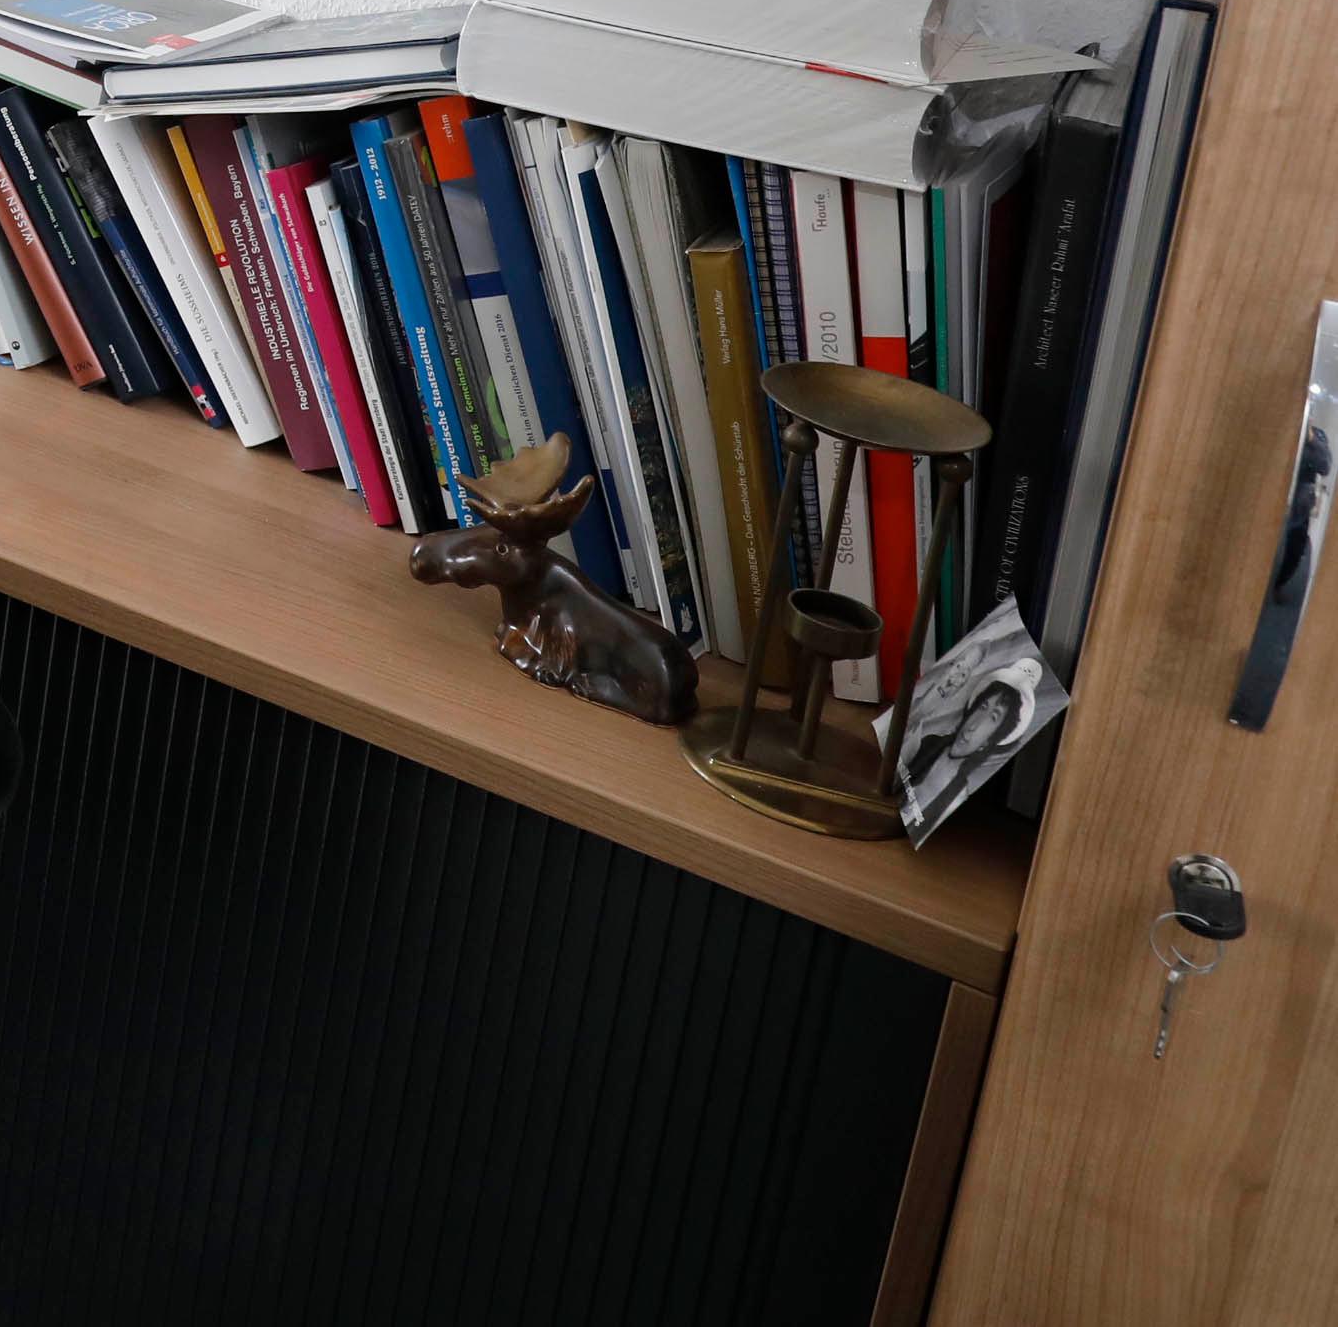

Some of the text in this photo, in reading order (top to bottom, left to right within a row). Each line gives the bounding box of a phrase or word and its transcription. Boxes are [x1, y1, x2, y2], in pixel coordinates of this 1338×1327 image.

[0, 105, 37, 182] Personalberatung
[439, 113, 452, 138] rehm
[365, 146, 386, 200] 1912 2012
[814, 192, 827, 226] Haufe
[5, 194, 35, 246] WISSEN
[228, 217, 258, 285] REVOLUTION
[277, 192, 314, 292] Die Goldschläger von Schwabach
[154, 315, 164, 326] für
[225, 162, 312, 411] Regionen im Umbruch: Franken, Schwaben, Bayern
[250, 284, 282, 361] INDUSTRIELLE
[406, 193, 475, 413] Gemeinsam Mehr als nur Zahlen aus 50 Jahren DATEV
[1043, 274, 1062, 313] Naseer
[160, 324, 180, 355] Handbuch
[199, 324, 212, 343] DIE
[712, 288, 732, 364] Verlag Hans Müller
[1033, 317, 1055, 368] Architect
[411, 325, 463, 476] Bayerische Staatszeitung
[493, 312, 532, 431] im öffentlichen Dienst 2016
[370, 398, 404, 501] Kulturstrategie der Stadt Nürnberg
[469, 422, 492, 477] 1966 2016
[729, 421, 762, 595] NÜRNBERG Das Geschlecht der Schürstab
[993, 473, 1030, 602] CITY OF CIVILIZATIONS
